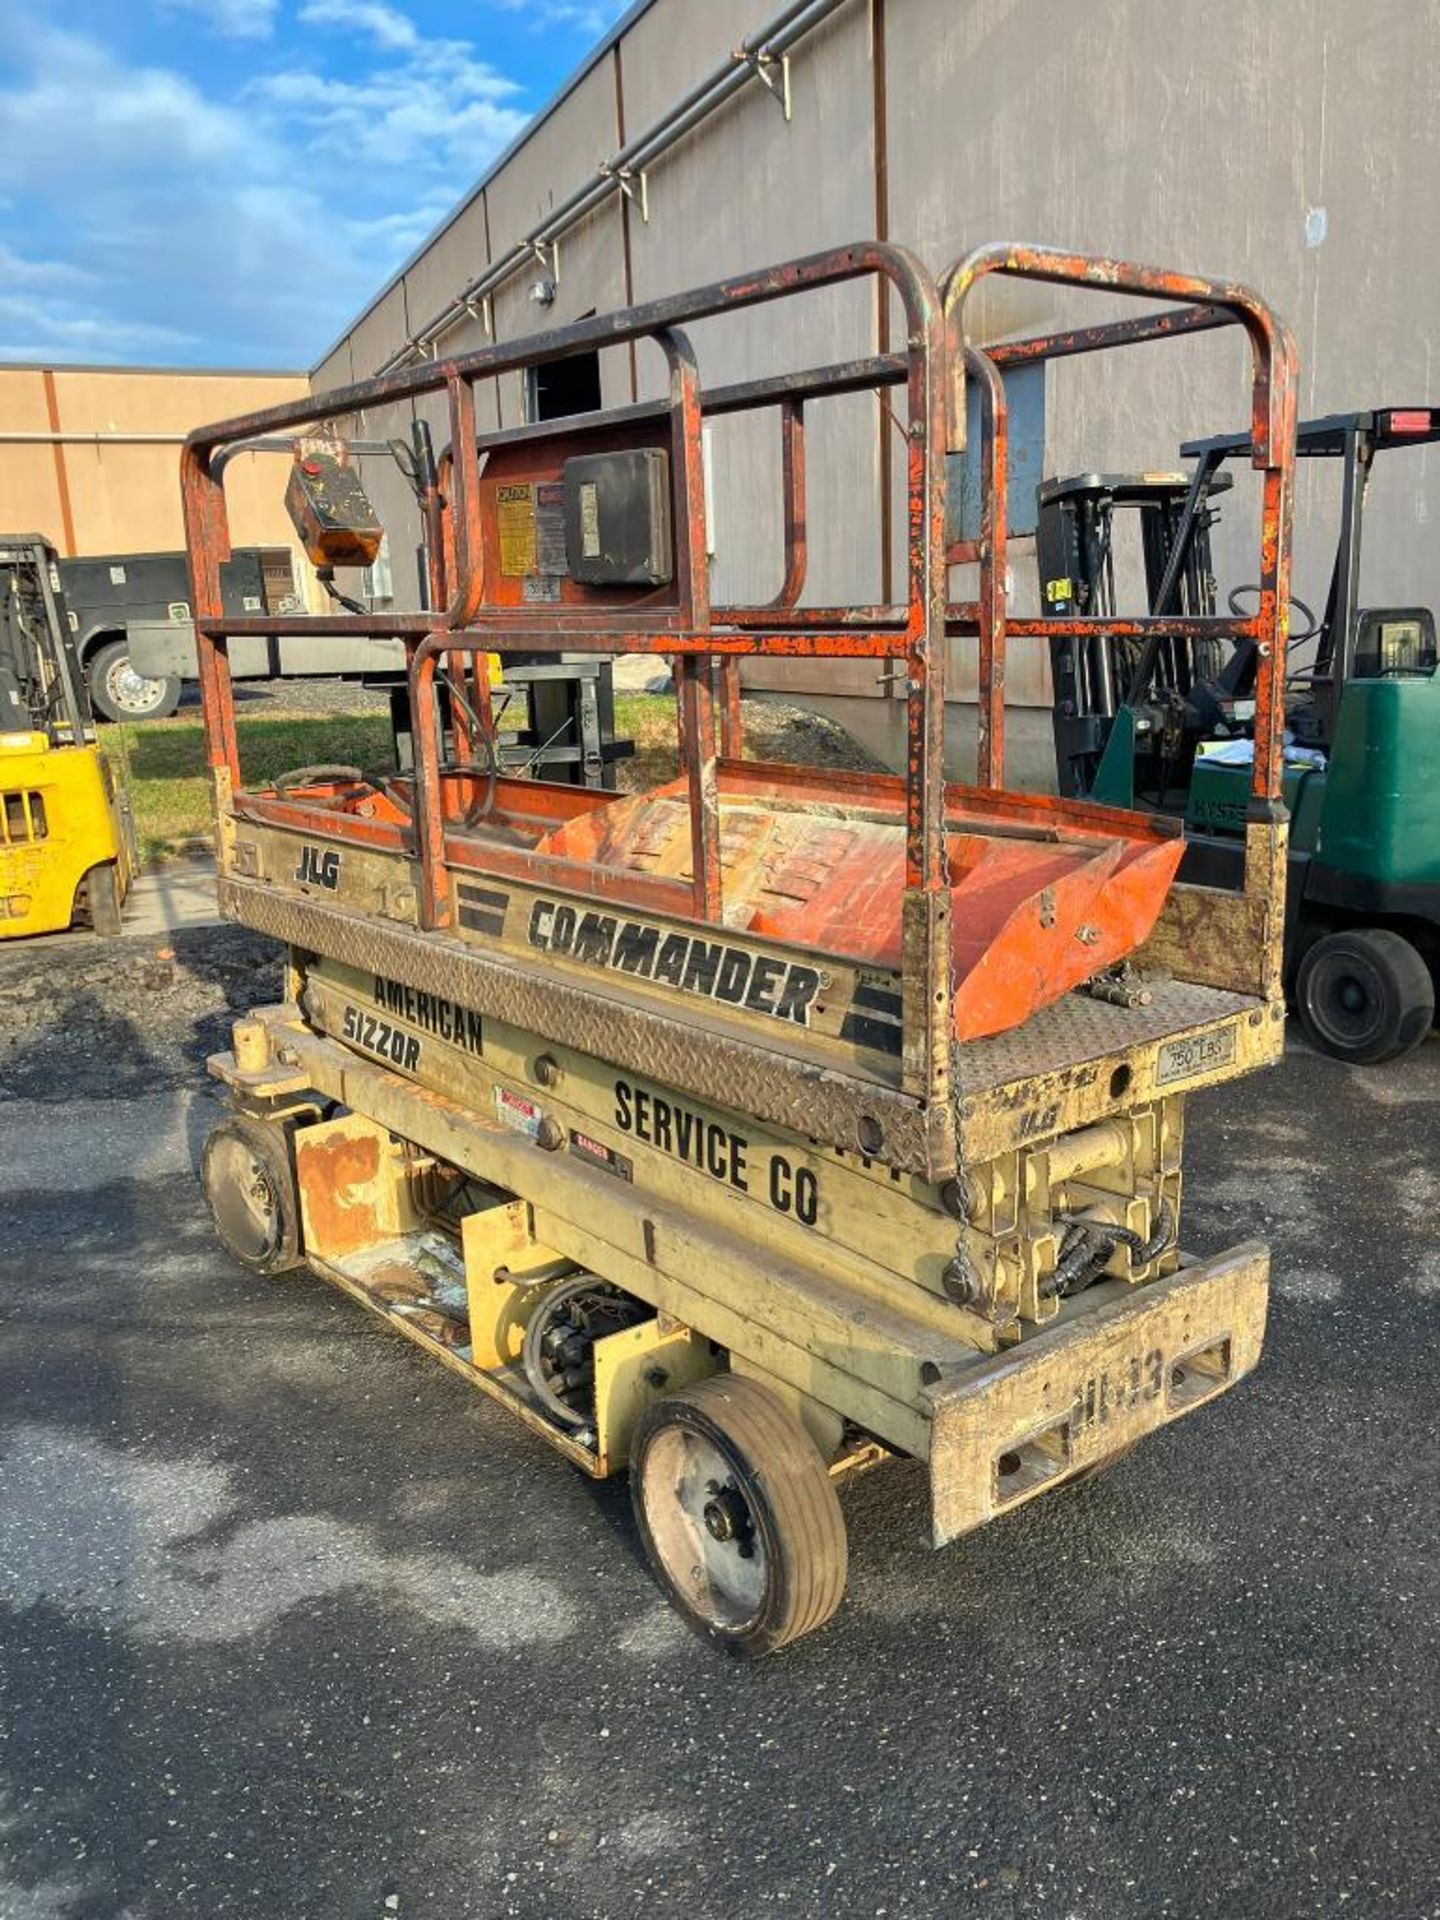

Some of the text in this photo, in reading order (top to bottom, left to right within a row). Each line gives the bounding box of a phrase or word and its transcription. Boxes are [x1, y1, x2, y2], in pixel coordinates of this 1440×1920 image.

[294, 845, 341, 892] JLG
[527, 899, 823, 1028] COMMANDER
[342, 1005, 421, 1073] SIZZOR
[374, 975, 484, 1057] AMERICAN
[1170, 1047, 1194, 1068] 750
[614, 1079, 748, 1192] SERVICE
[769, 1154, 818, 1226] CO
